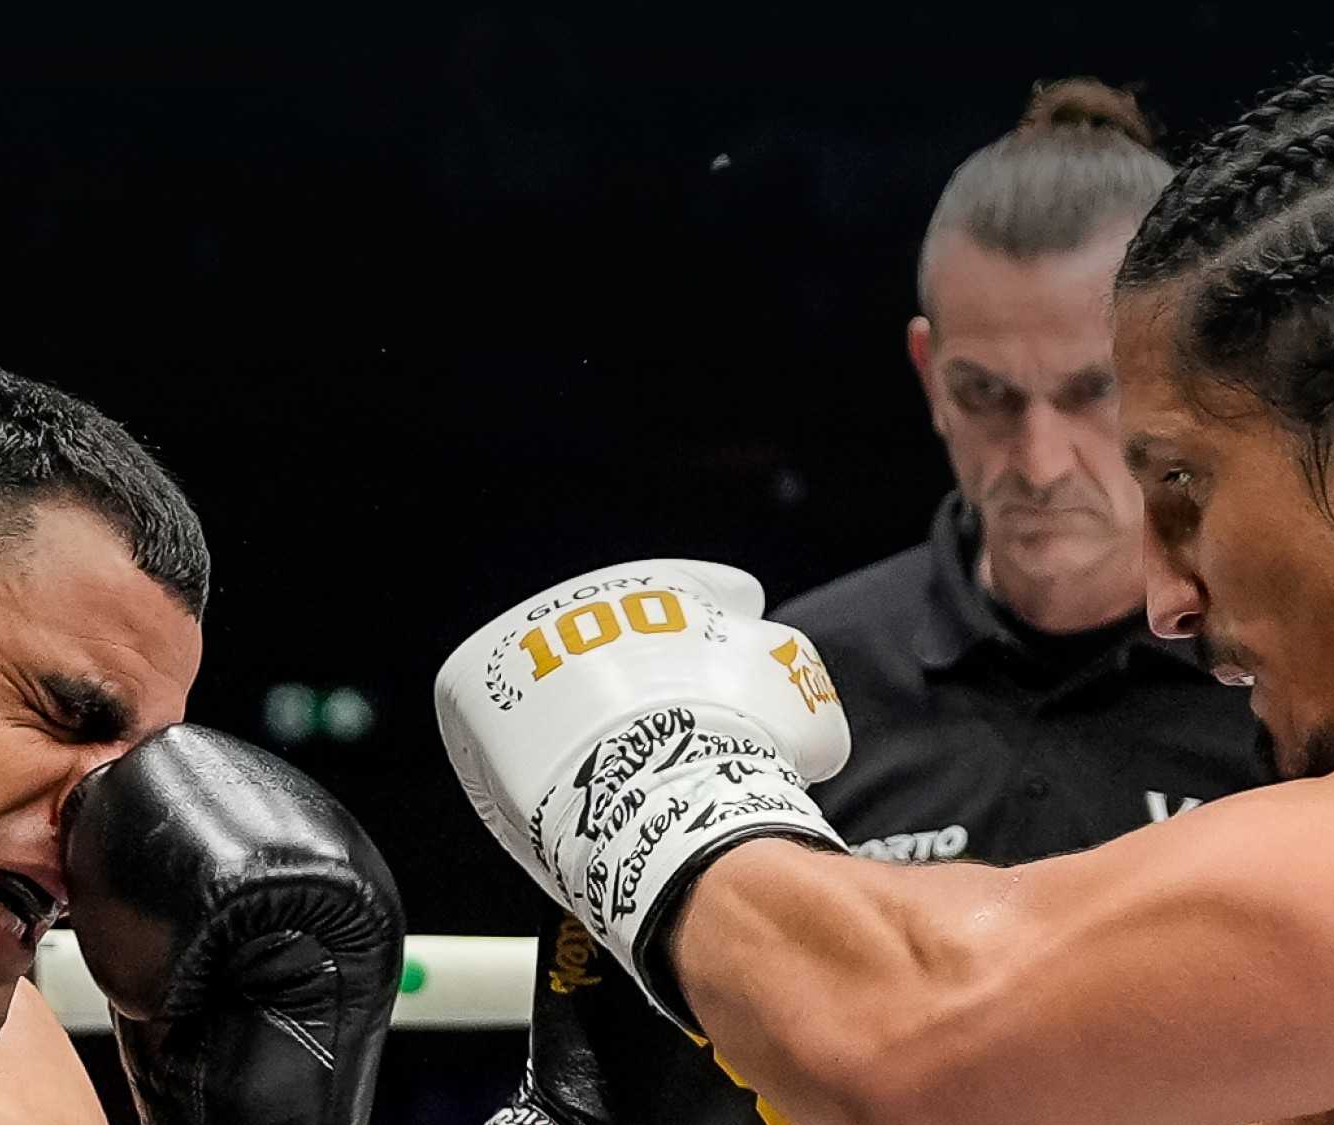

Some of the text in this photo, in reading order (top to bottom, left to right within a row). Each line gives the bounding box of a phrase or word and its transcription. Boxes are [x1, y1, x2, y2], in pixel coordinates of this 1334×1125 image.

[518, 590, 688, 682] 100
[526, 576, 653, 622] GLORY
[610, 796, 690, 922] Fairtex
